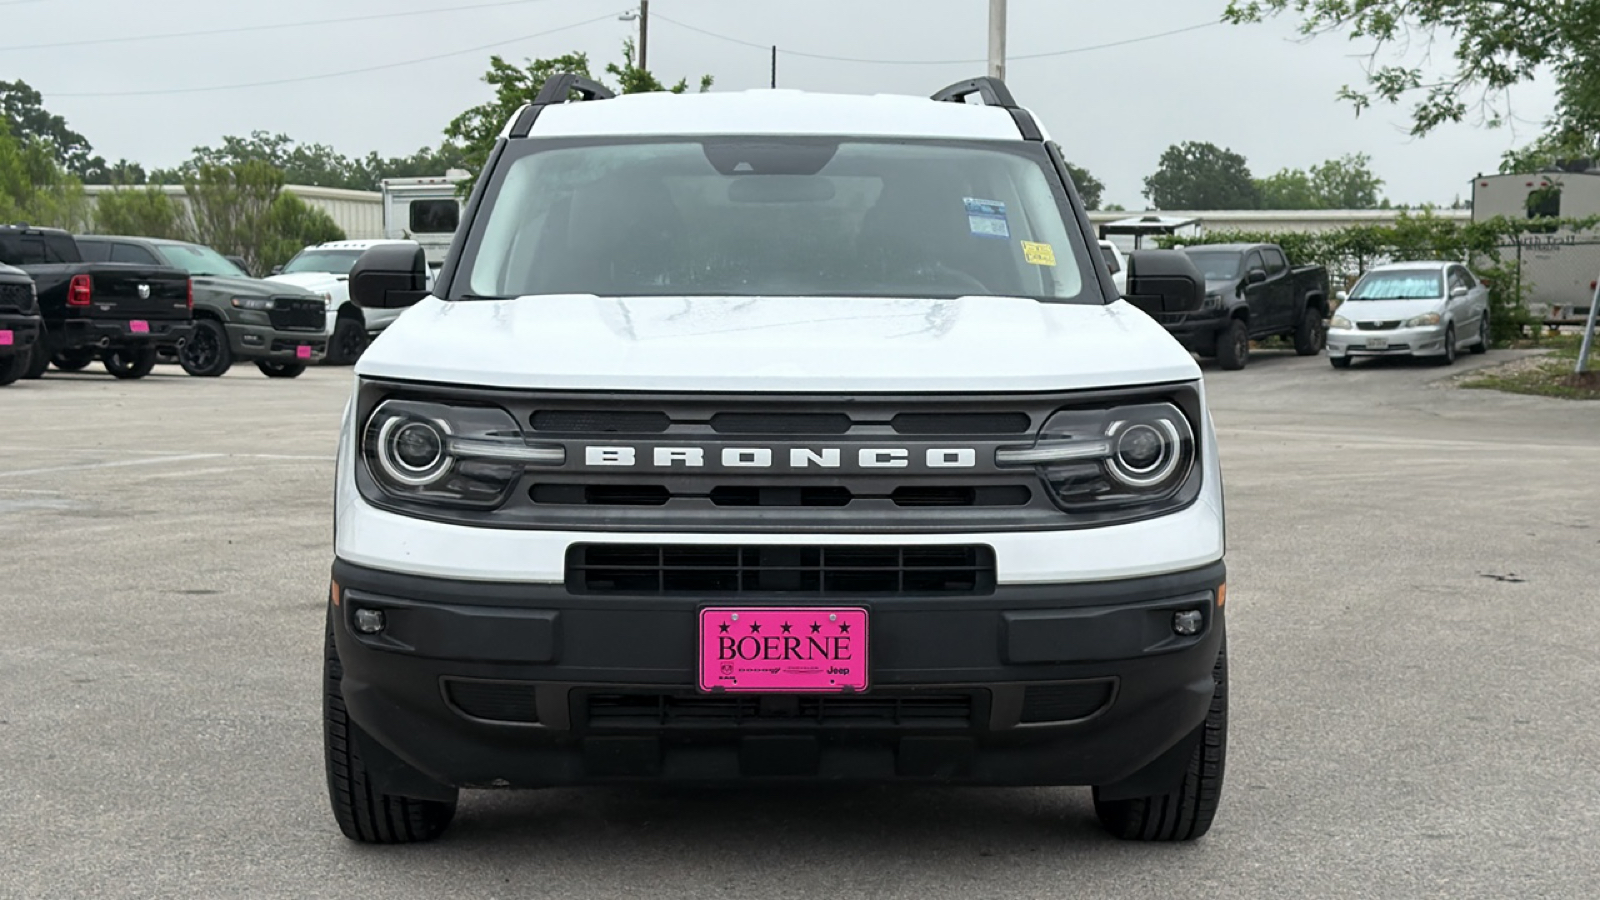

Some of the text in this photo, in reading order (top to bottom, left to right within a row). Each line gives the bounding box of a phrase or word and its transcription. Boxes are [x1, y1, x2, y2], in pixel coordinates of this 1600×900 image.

[585, 446, 976, 468] BRONCO
[717, 635, 852, 661] BOERNE
[827, 666, 849, 675] Jeep
